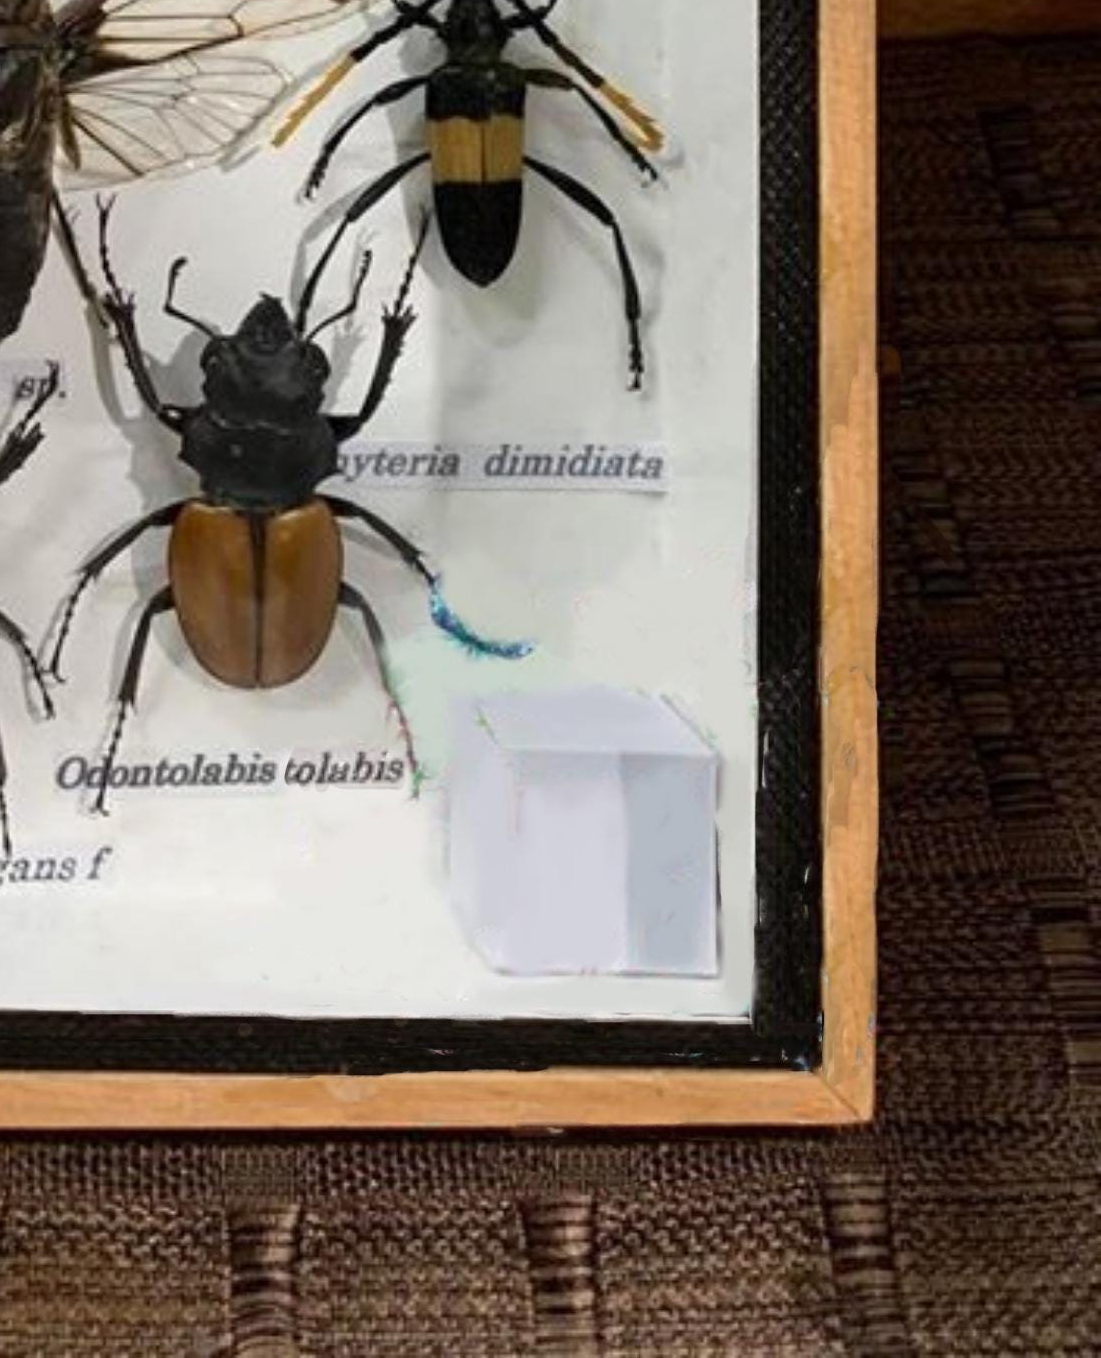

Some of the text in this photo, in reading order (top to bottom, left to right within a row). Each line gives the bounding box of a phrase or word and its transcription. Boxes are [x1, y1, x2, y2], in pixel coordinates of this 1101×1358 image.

[483, 443, 664, 479] dimidiata
[55, 752, 277, 789] Odontolabis
[86, 846, 113, 881] f
